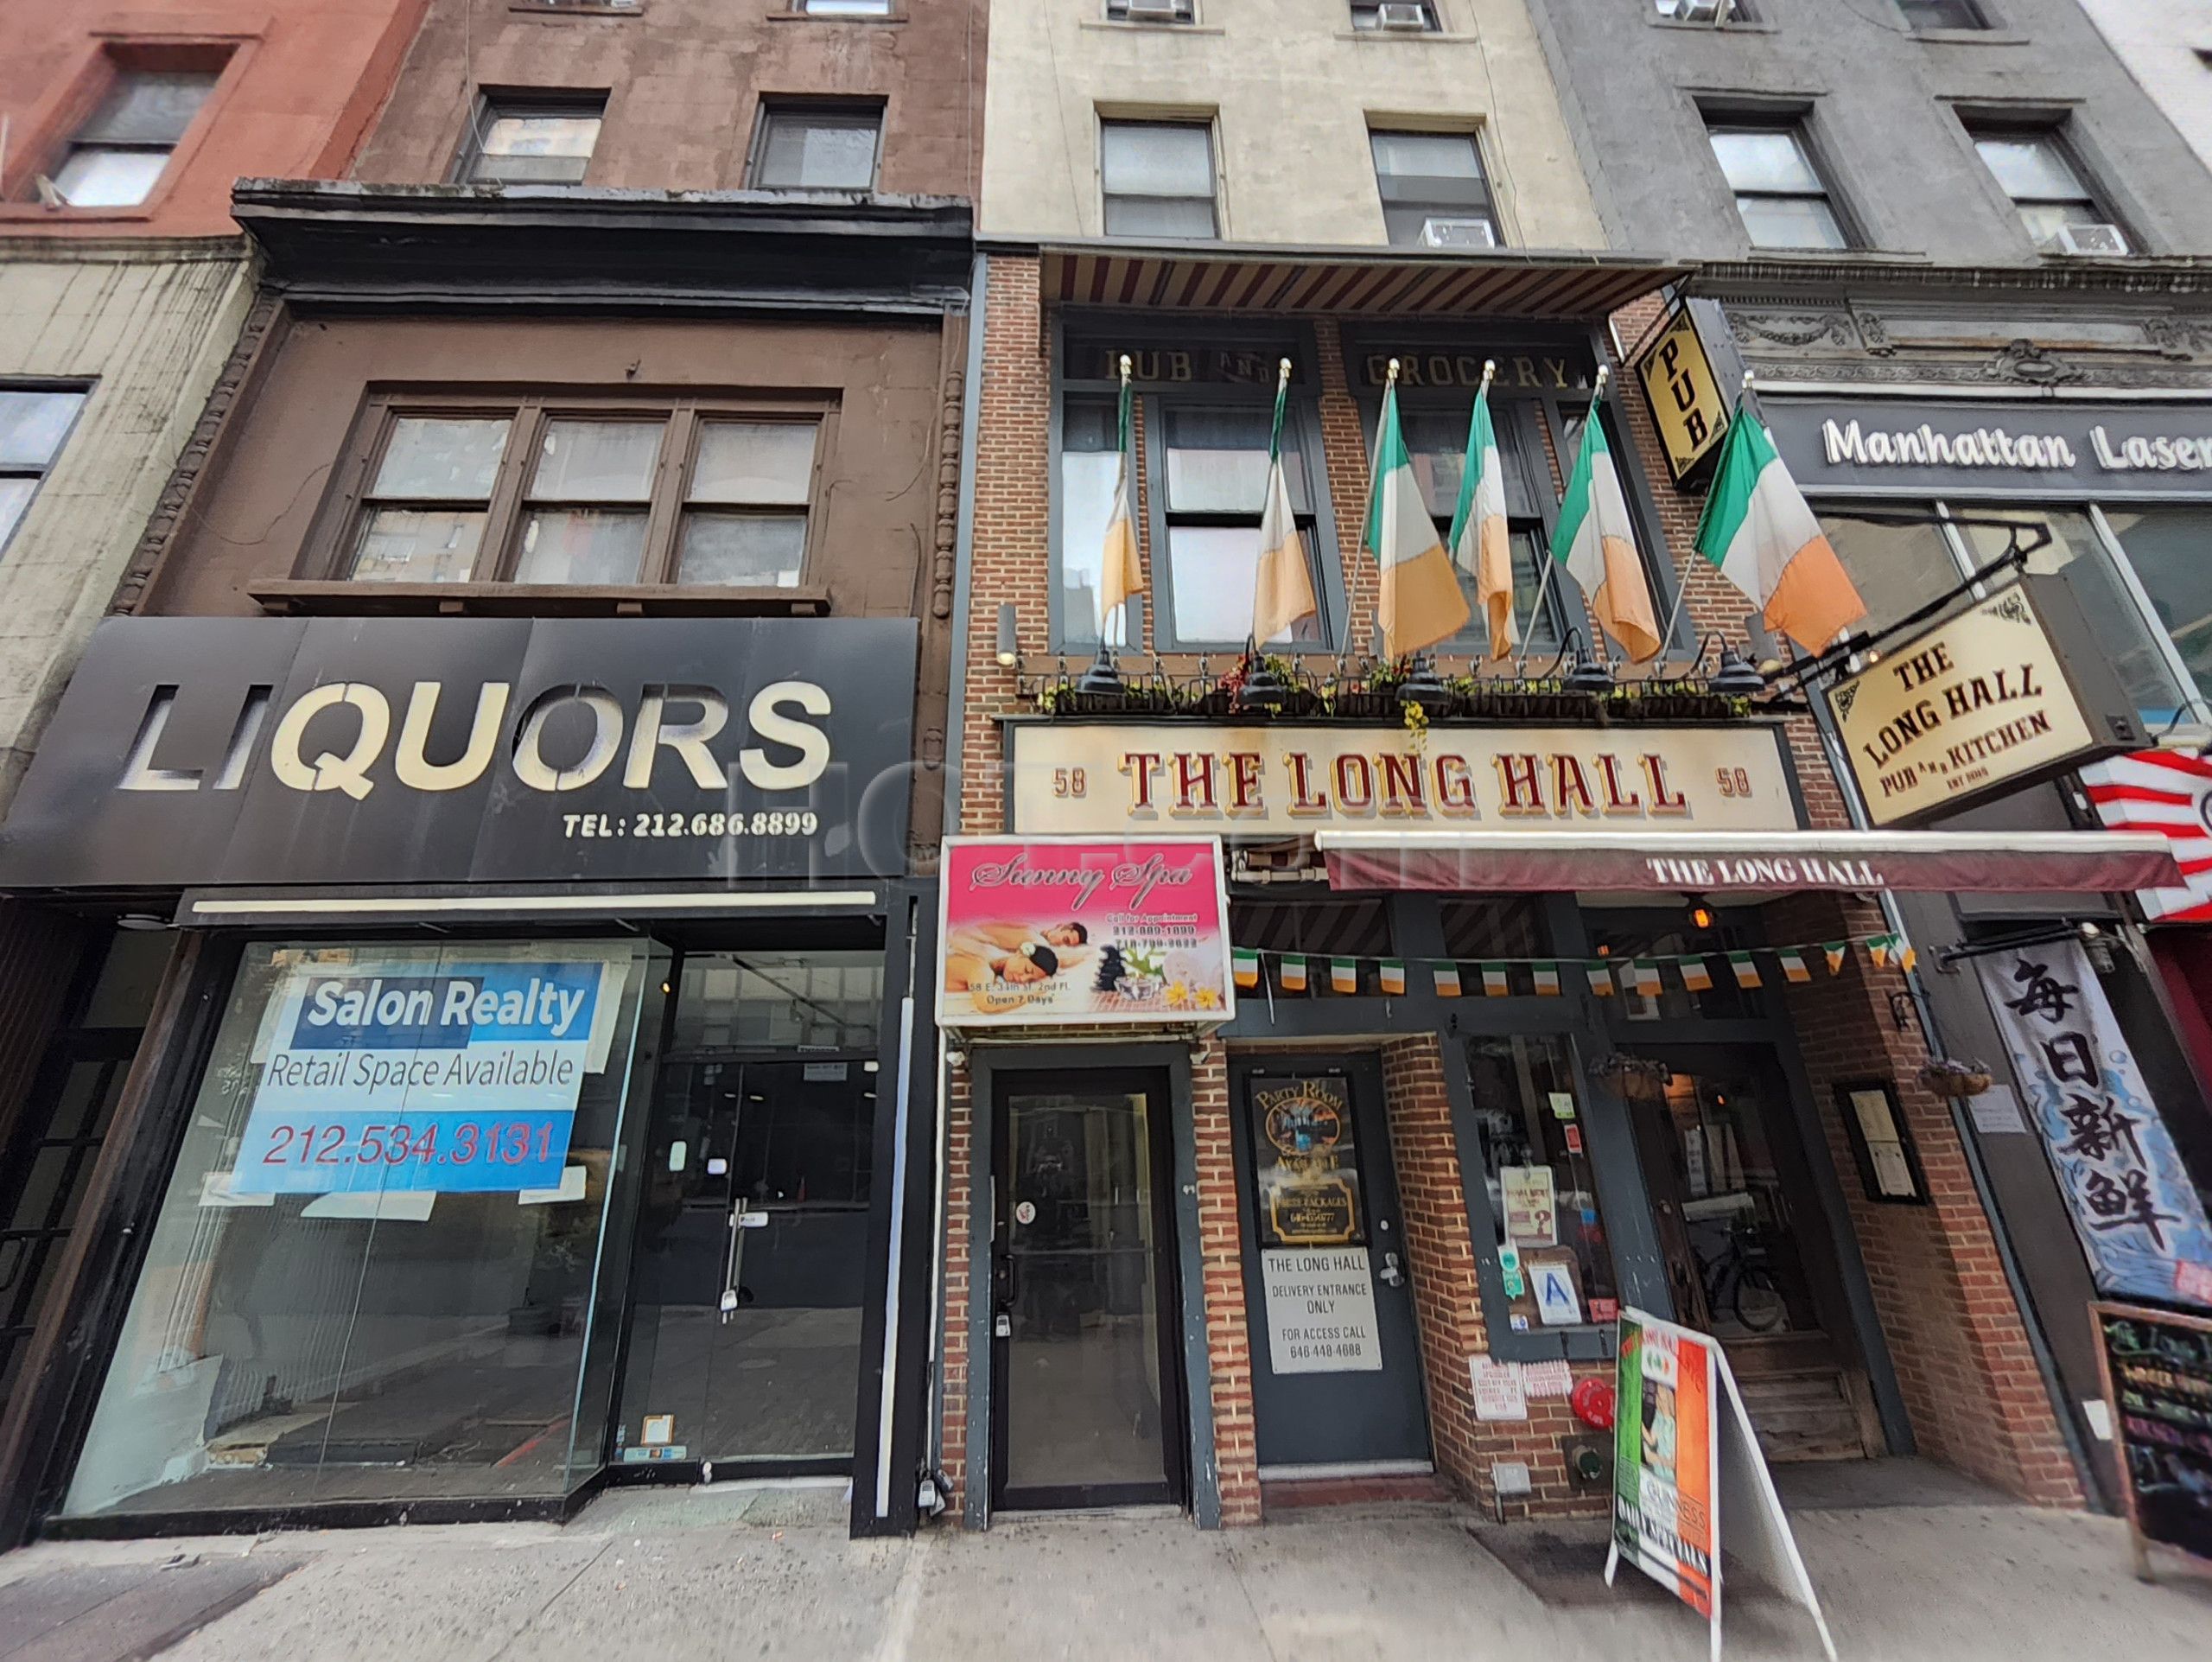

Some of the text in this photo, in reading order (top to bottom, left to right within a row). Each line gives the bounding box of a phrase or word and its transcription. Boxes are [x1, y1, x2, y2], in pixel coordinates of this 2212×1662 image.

[1105, 350, 1192, 381] PUB
[1367, 354, 1567, 387] GROCERY
[1659, 337, 1707, 453] PUB
[1821, 418, 2075, 468] Manhattan
[1892, 641, 1955, 692] THE
[1863, 663, 2043, 770] LONG HALL
[118, 681, 830, 800] LIQUORS
[1879, 766, 1918, 798] PUB
[1946, 710, 2053, 769] KITCHEN
[1052, 752, 1753, 818] 58 THE LONG HALL 58
[563, 812, 818, 838] TEL: 212.686.8899
[969, 852, 1193, 911] Sunny Spa
[1645, 857, 1885, 886] THE LONG HALL
[1140, 913, 1198, 925] Appointment
[307, 977, 586, 1036] Salon Realty
[986, 994, 1054, 1006] Open 7 Days
[267, 1049, 574, 1095] Retail Space Available
[1255, 1086, 1299, 1111] PARTY
[262, 1122, 554, 1166] 212.534.3131
[1268, 1255, 1365, 1272] THE LONG HALL
[1272, 1283, 1367, 1297] DELIVERY ENTRANCE
[1306, 1299, 1335, 1314] ONLY
[1281, 1325, 1366, 1341] FOR ACCESS CALL
